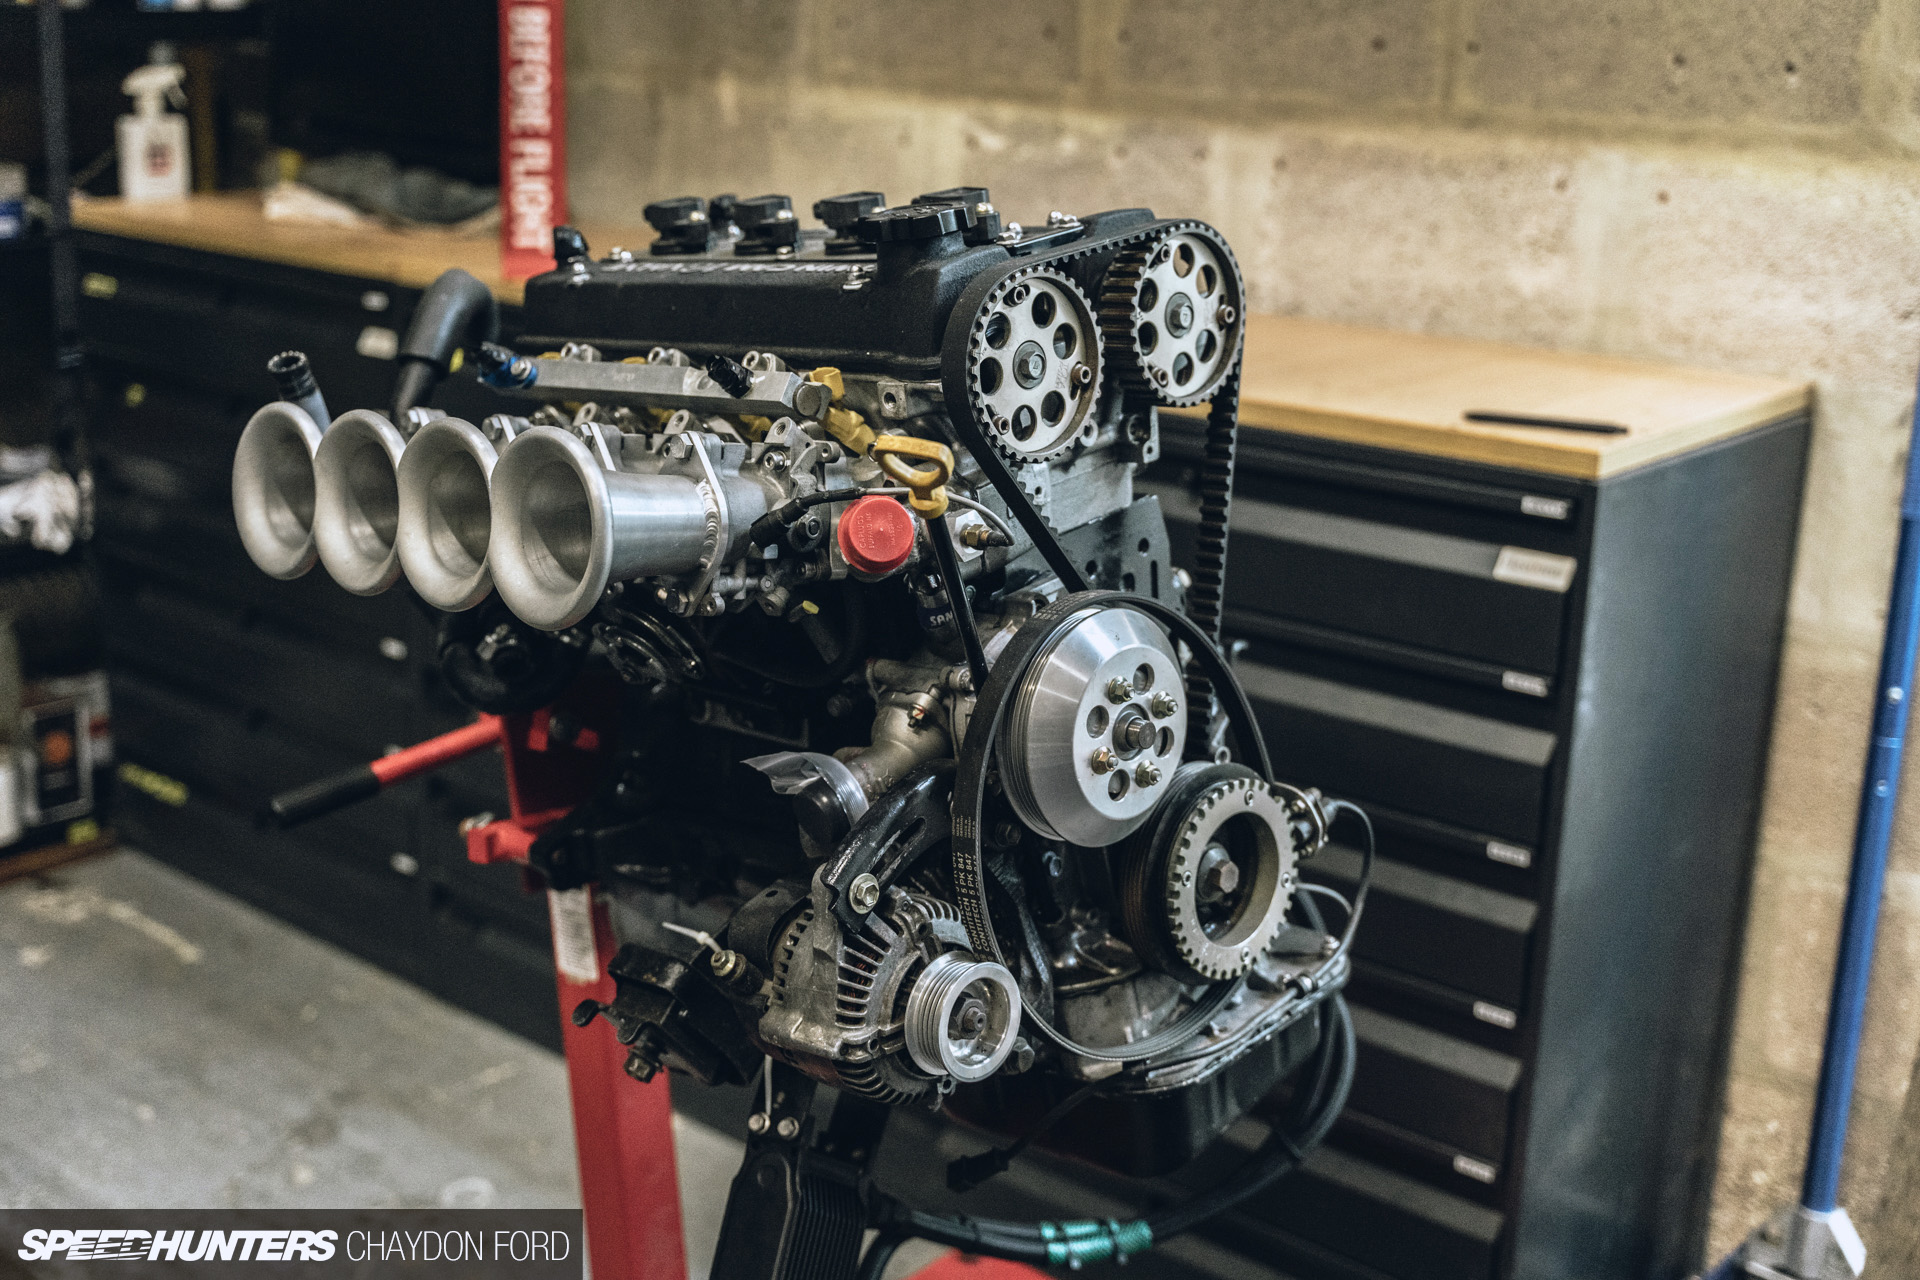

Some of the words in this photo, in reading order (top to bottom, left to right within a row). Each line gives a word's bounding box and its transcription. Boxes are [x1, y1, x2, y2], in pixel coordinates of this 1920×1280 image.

[857, 515, 867, 549] CAPLUGS
[959, 871, 966, 886] PK
[967, 873, 975, 887] PK
[963, 897, 982, 950] CONTITECH
[971, 899, 990, 952] CONTITECH
